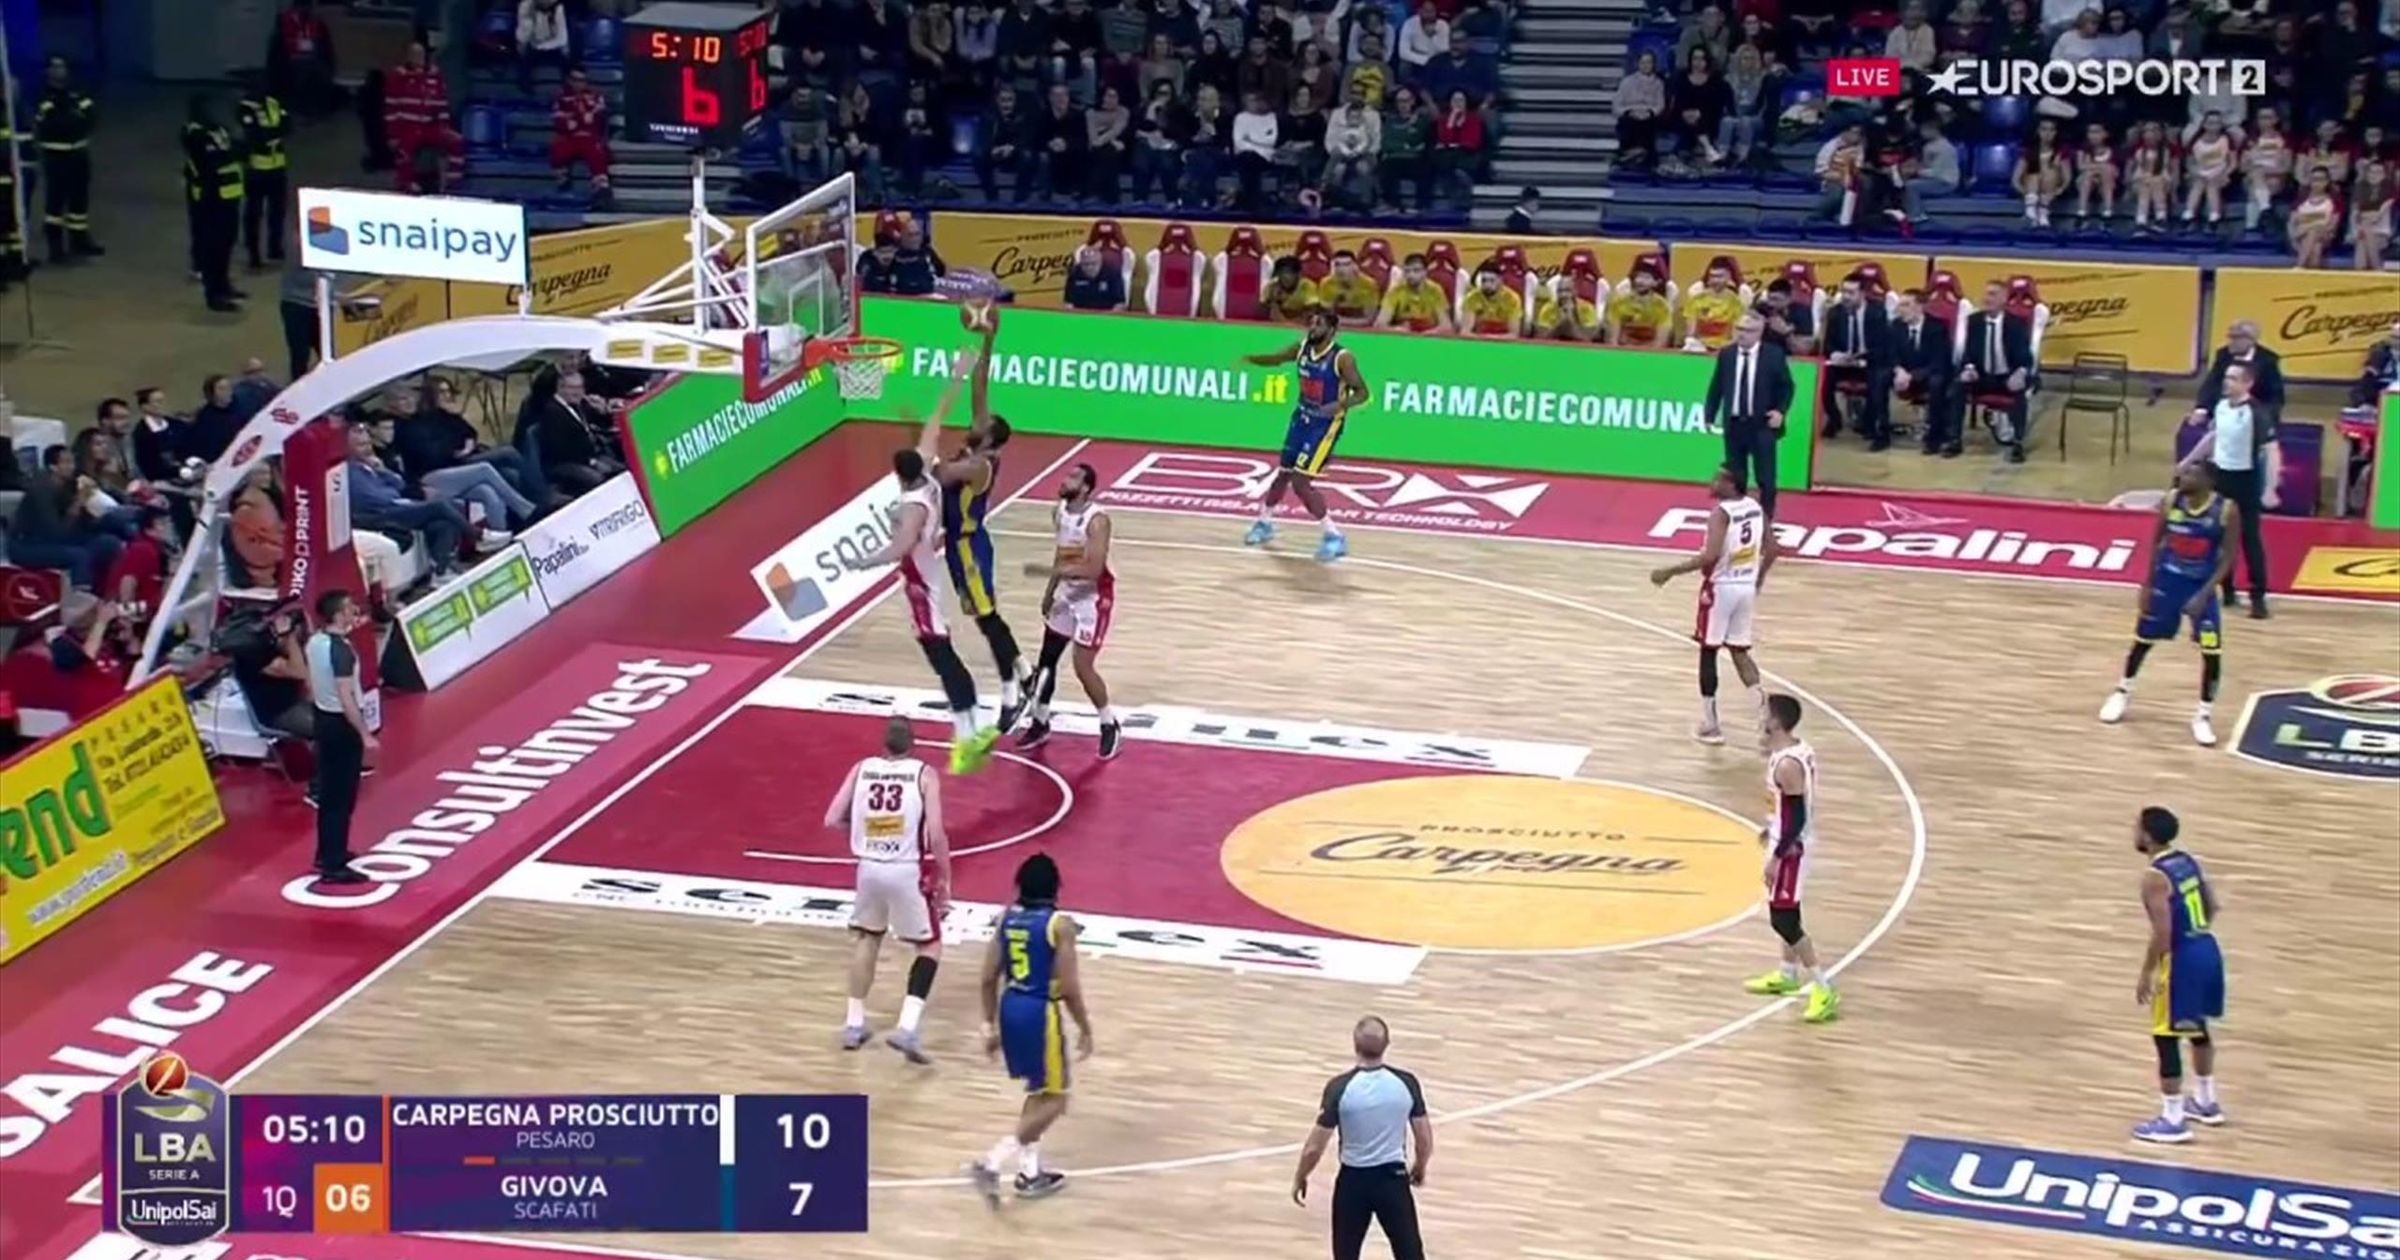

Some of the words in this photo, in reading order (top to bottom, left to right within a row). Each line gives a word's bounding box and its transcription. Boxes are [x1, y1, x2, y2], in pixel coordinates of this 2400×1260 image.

[651, 31, 721, 63] 5:10
[358, 217, 517, 264] snaipay
[991, 246, 1077, 285] Carpeg
[2047, 293, 2129, 327] pegna
[913, 347, 1289, 405] FAMACIECOMUNALI.it
[1384, 382, 1724, 436] FARMACIECOMUNA
[1362, 511, 1515, 531] TECHNOLOGY
[1740, 520, 1753, 546] 5
[280, 657, 713, 909] Consultinvest
[868, 782, 904, 812] 33
[1418, 823, 1627, 842] PROSCIUTTO
[1309, 832, 1687, 874] Carpegna
[1009, 941, 1031, 980] 5
[1948, 1152, 2400, 1248] UnipolSa
